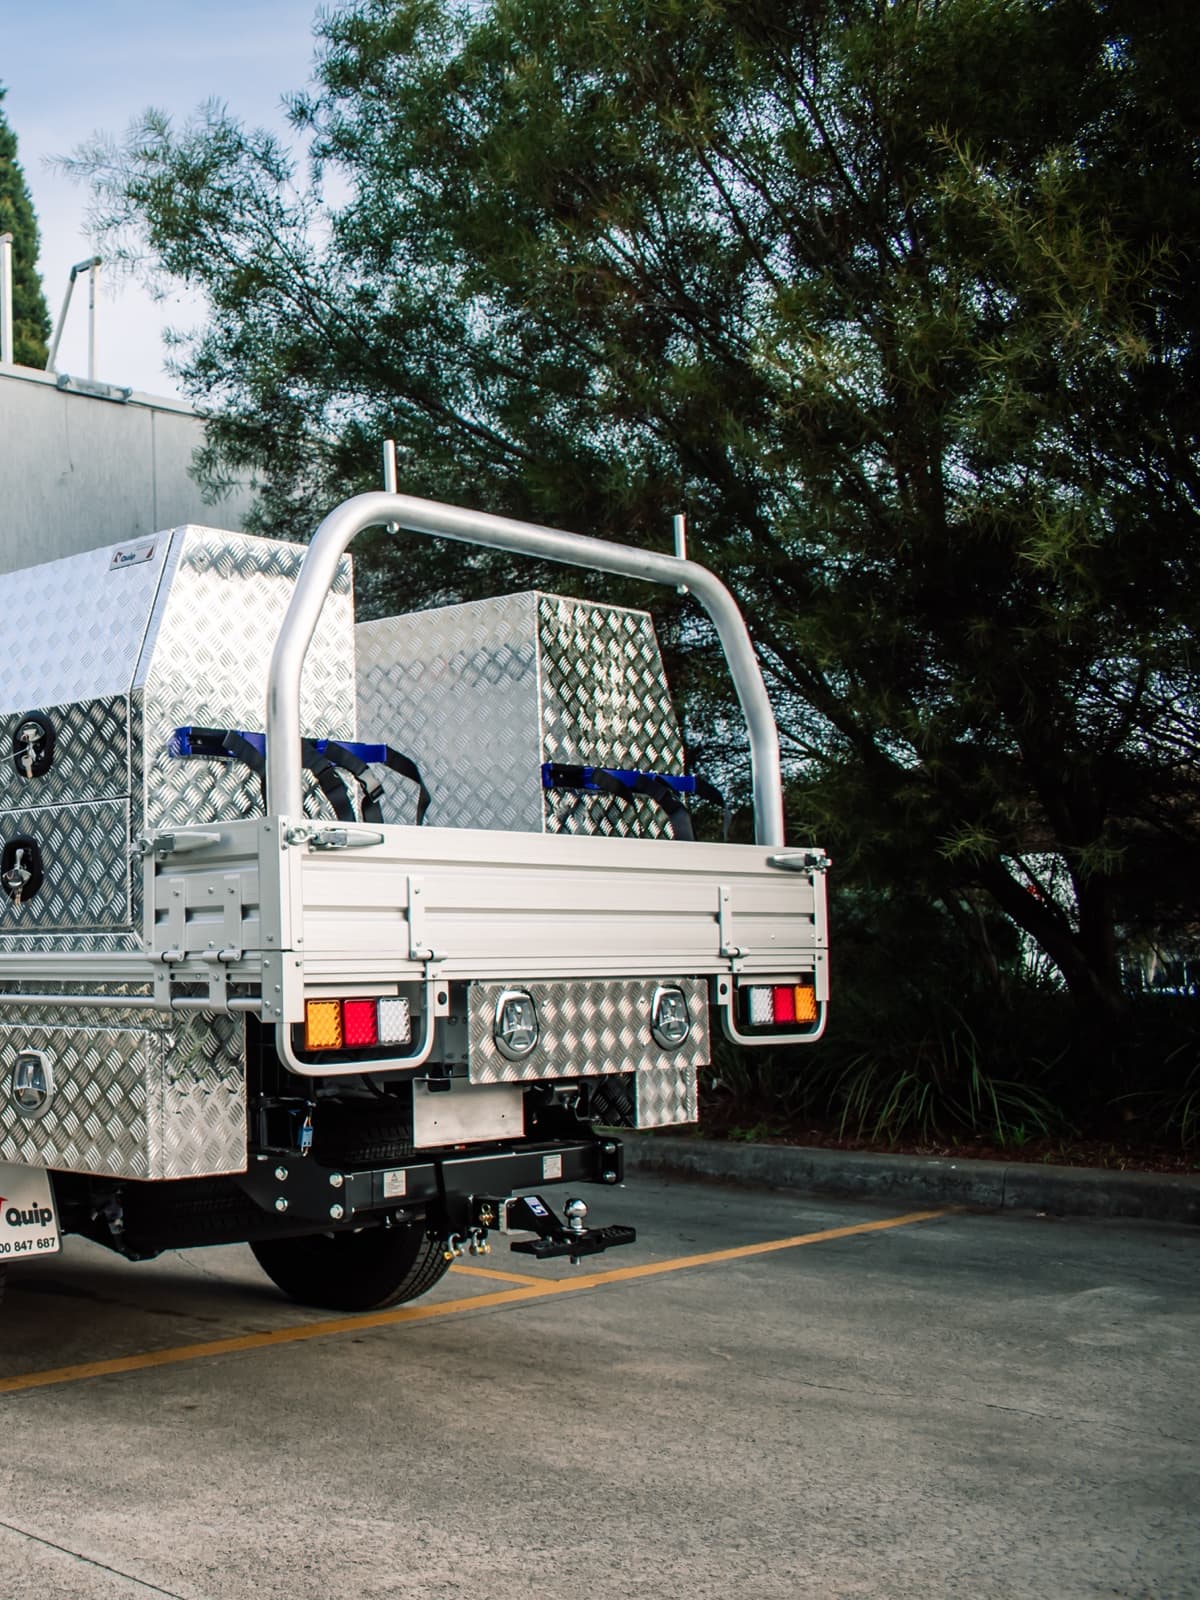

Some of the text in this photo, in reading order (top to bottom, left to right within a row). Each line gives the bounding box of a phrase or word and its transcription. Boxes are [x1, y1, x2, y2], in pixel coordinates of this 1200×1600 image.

[5, 1202, 53, 1227] Quip
[14, 1240, 33, 1252] 847
[37, 1237, 56, 1249] 687
